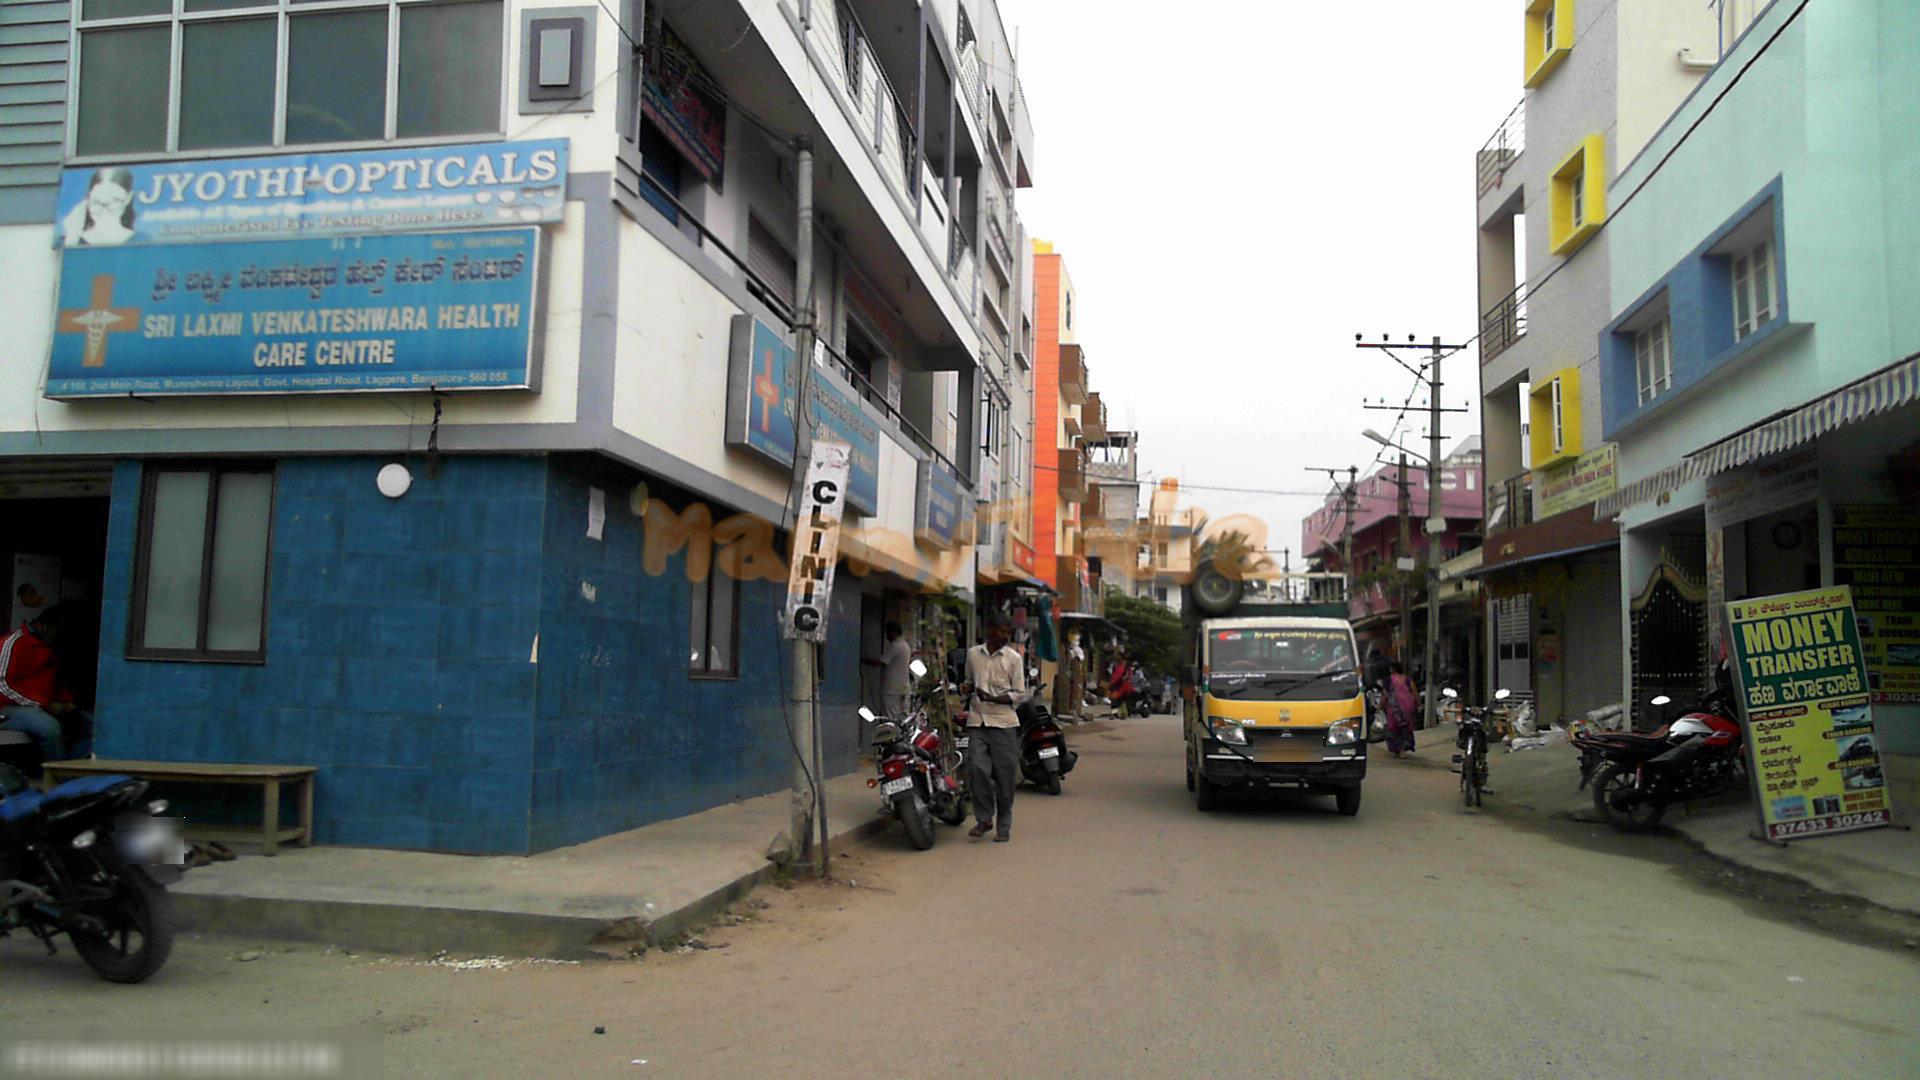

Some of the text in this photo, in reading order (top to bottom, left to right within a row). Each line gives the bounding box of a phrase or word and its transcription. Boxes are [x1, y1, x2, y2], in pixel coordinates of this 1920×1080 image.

[138, 149, 558, 204] JYOTHI OPTICALS
[144, 303, 521, 338] SRI LAXMI VENKATESHWARA HEALTH
[254, 339, 395, 368] CARE CENTRE
[793, 480, 838, 632] CLINIC
[1742, 610, 1844, 654] MONEY
[1747, 644, 1855, 678] TRANSFER
[1748, 681, 1776, 705] ಹಣ
[1776, 810, 1883, 836] 97433 30242
